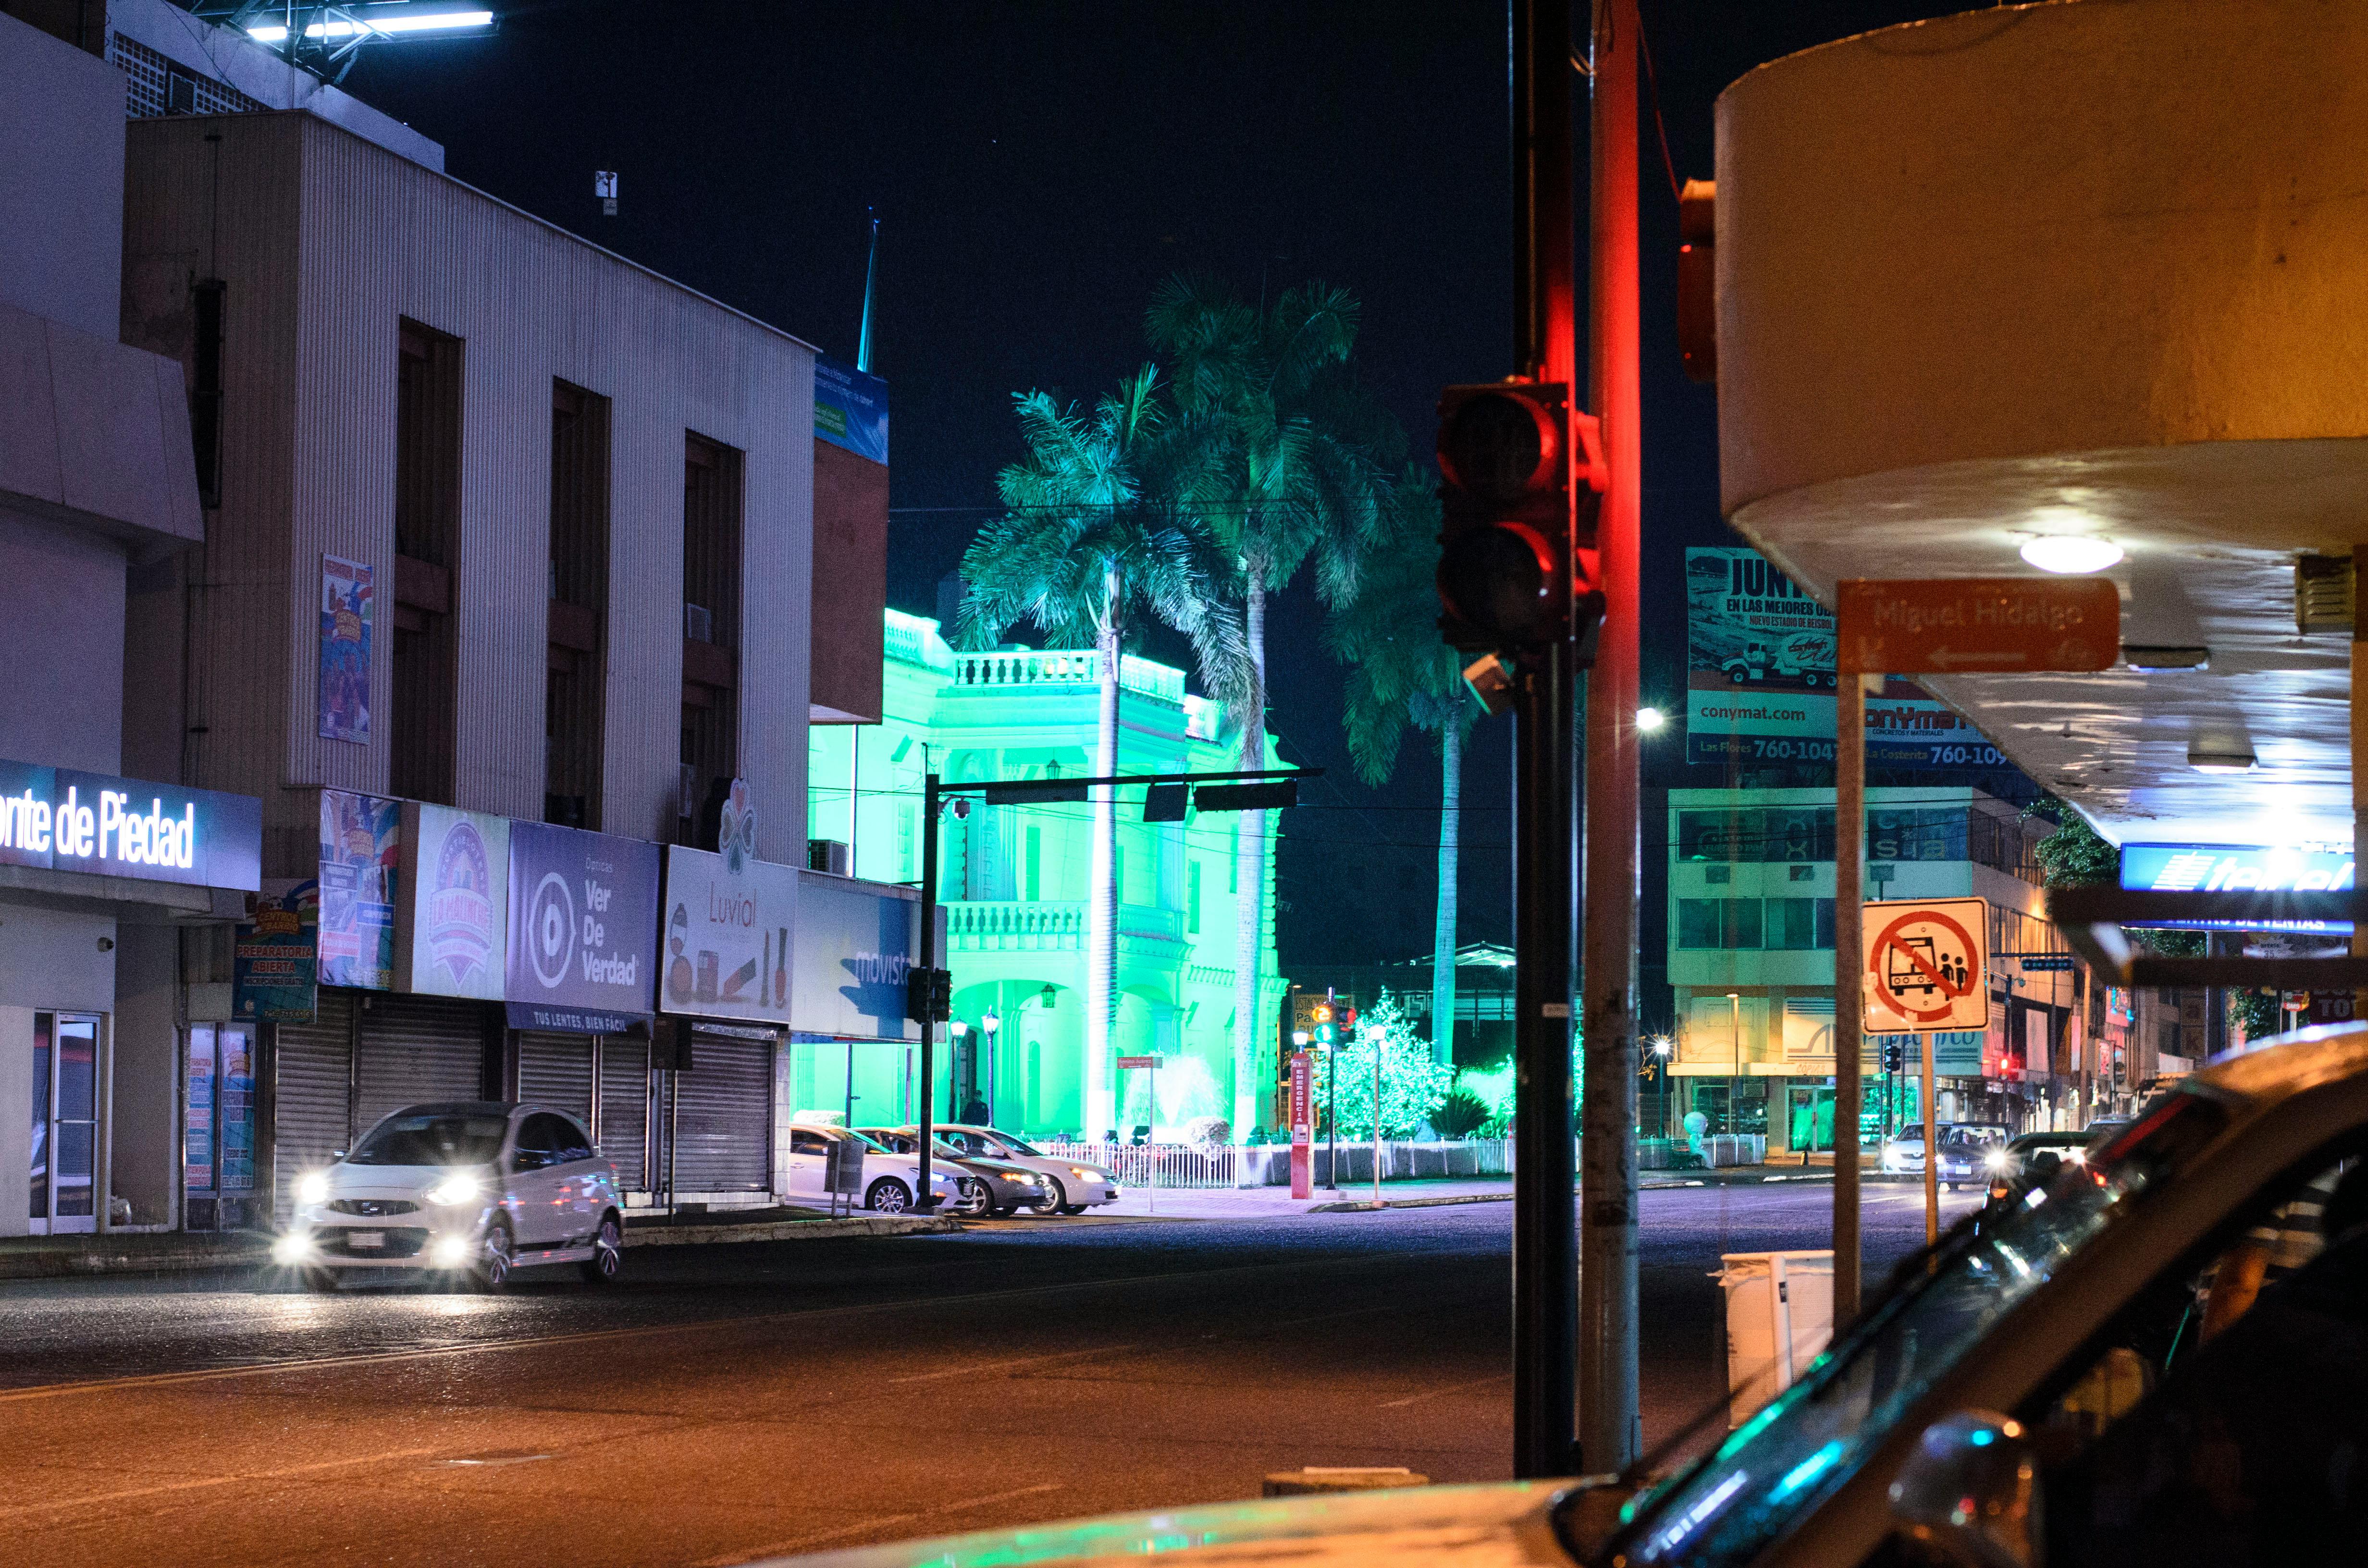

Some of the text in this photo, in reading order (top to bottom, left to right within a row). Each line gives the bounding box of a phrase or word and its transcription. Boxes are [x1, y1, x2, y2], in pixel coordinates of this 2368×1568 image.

[1727, 599, 1740, 612] EN
[1742, 600, 1762, 612] LAS
[1764, 600, 1813, 615] MEJORES
[1874, 597, 2084, 633] Miguel Hidalgo
[1750, 615, 1771, 625] NUEVO
[1798, 617, 1806, 627] DE
[1700, 705, 1806, 722] conymat.com
[1701, 740, 1838, 760] Las Flores 760-104
[56, 786, 94, 858] de
[99, 790, 194, 869] Piedad
[585, 879, 611, 912] Ver
[710, 881, 756, 928] Luvial
[583, 915, 604, 946] De
[237, 945, 313, 958] PREPARATORIA
[251, 960, 296, 973] ABIERTA
[582, 951, 636, 986] Verdad
[534, 1011, 550, 1026] TUS
[551, 1013, 584, 1030] LENTES,
[585, 1016, 604, 1030] BIEN
[1796, 1063, 1825, 1074] COPIAS
